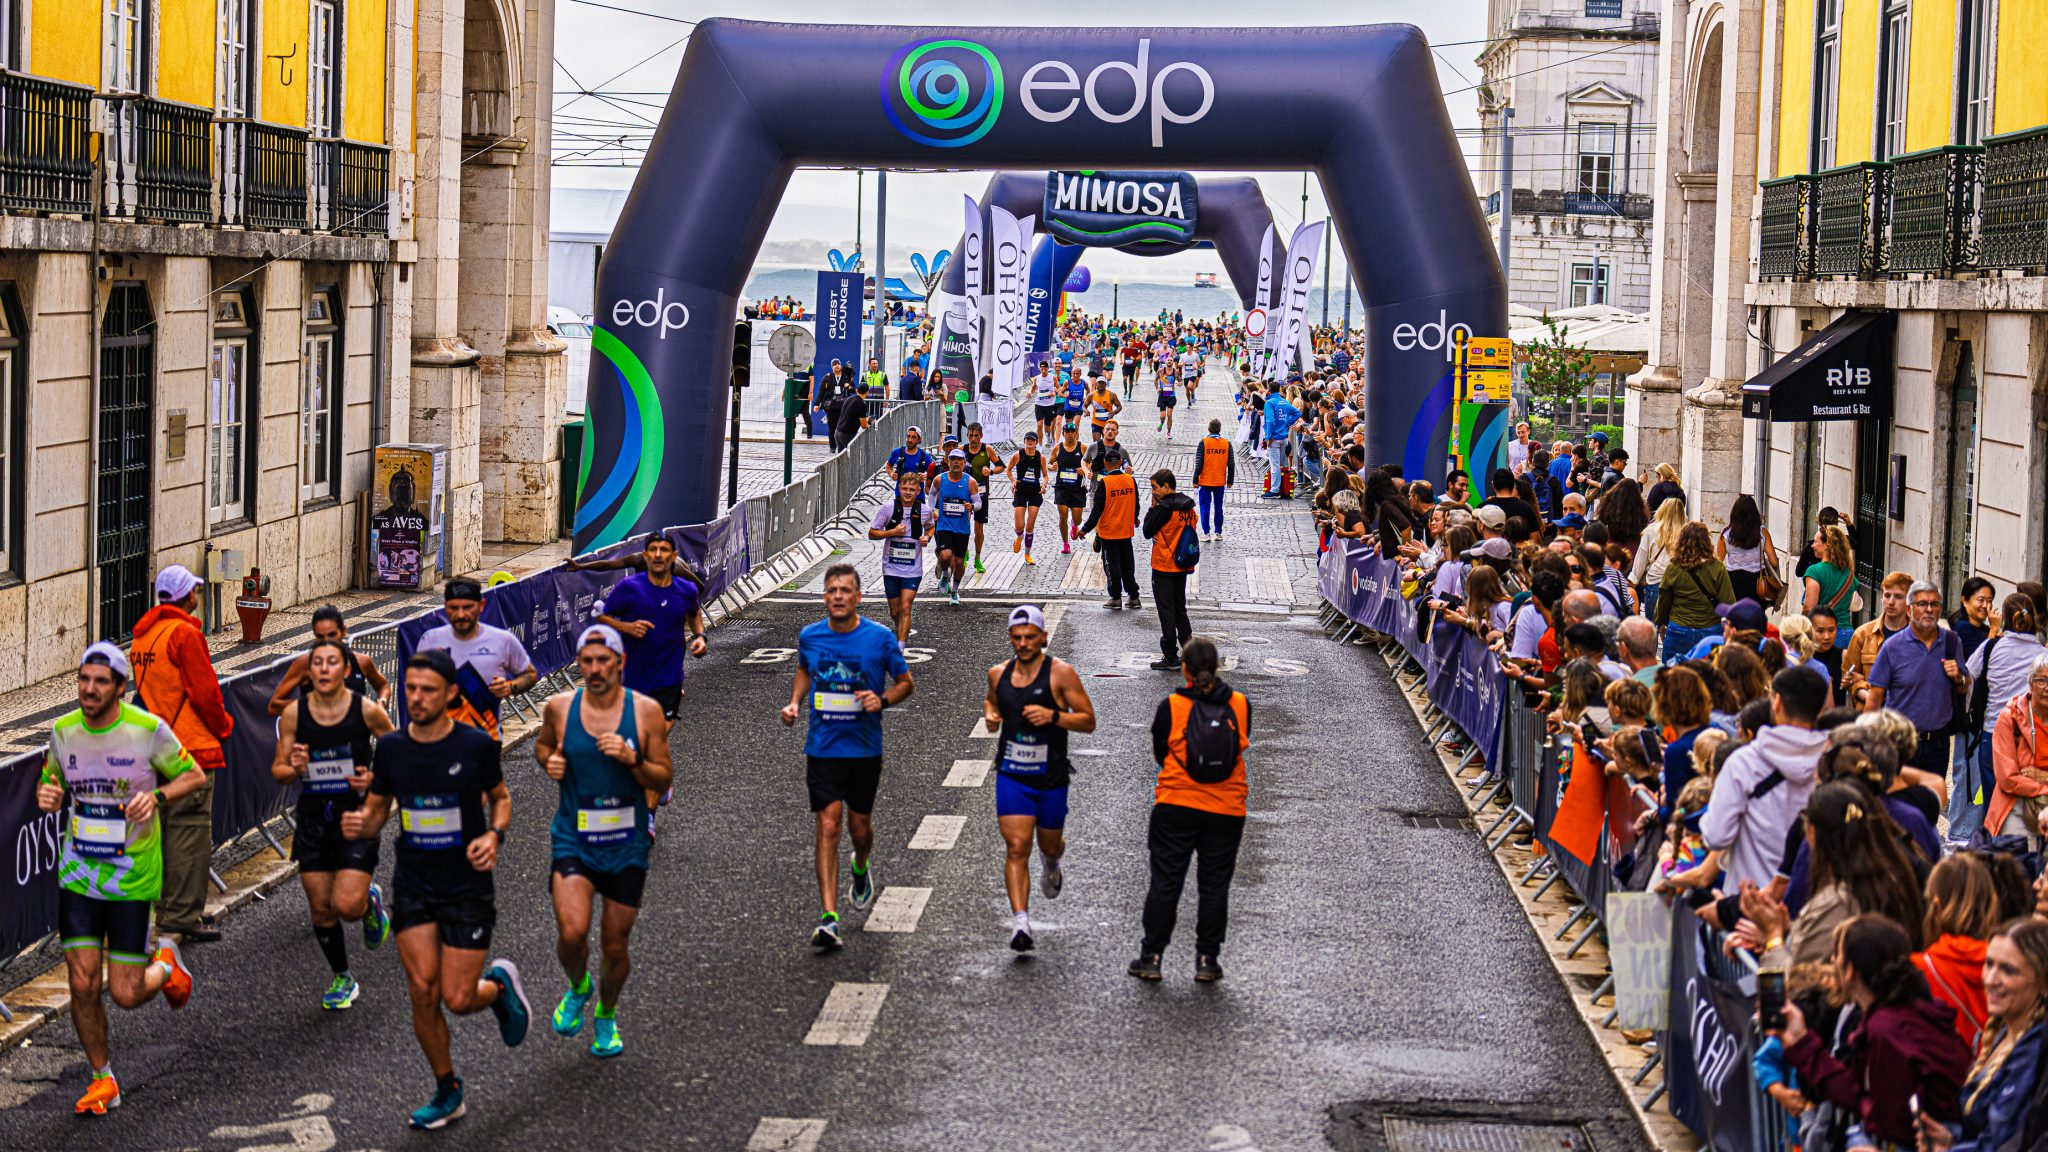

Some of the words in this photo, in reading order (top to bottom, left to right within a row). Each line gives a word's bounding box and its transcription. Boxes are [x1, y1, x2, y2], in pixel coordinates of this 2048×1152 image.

[1020, 38, 1216, 148] edp
[1054, 172, 1185, 219] MIMOSA
[611, 287, 690, 340] edp
[828, 289, 839, 340] GUEST
[838, 278, 849, 340] LOUNGE
[1024, 302, 1042, 353] HYUND
[941, 340, 971, 355] MIMOS
[1392, 308, 1474, 362] edp
[1813, 404, 1852, 416] Restaurant
[1853, 403, 1859, 414] &
[1859, 403, 1871, 415] Bar
[1110, 488, 1134, 497] STAFF
[392, 515, 424, 530] AVES
[16, 806, 66, 886] OYSH
